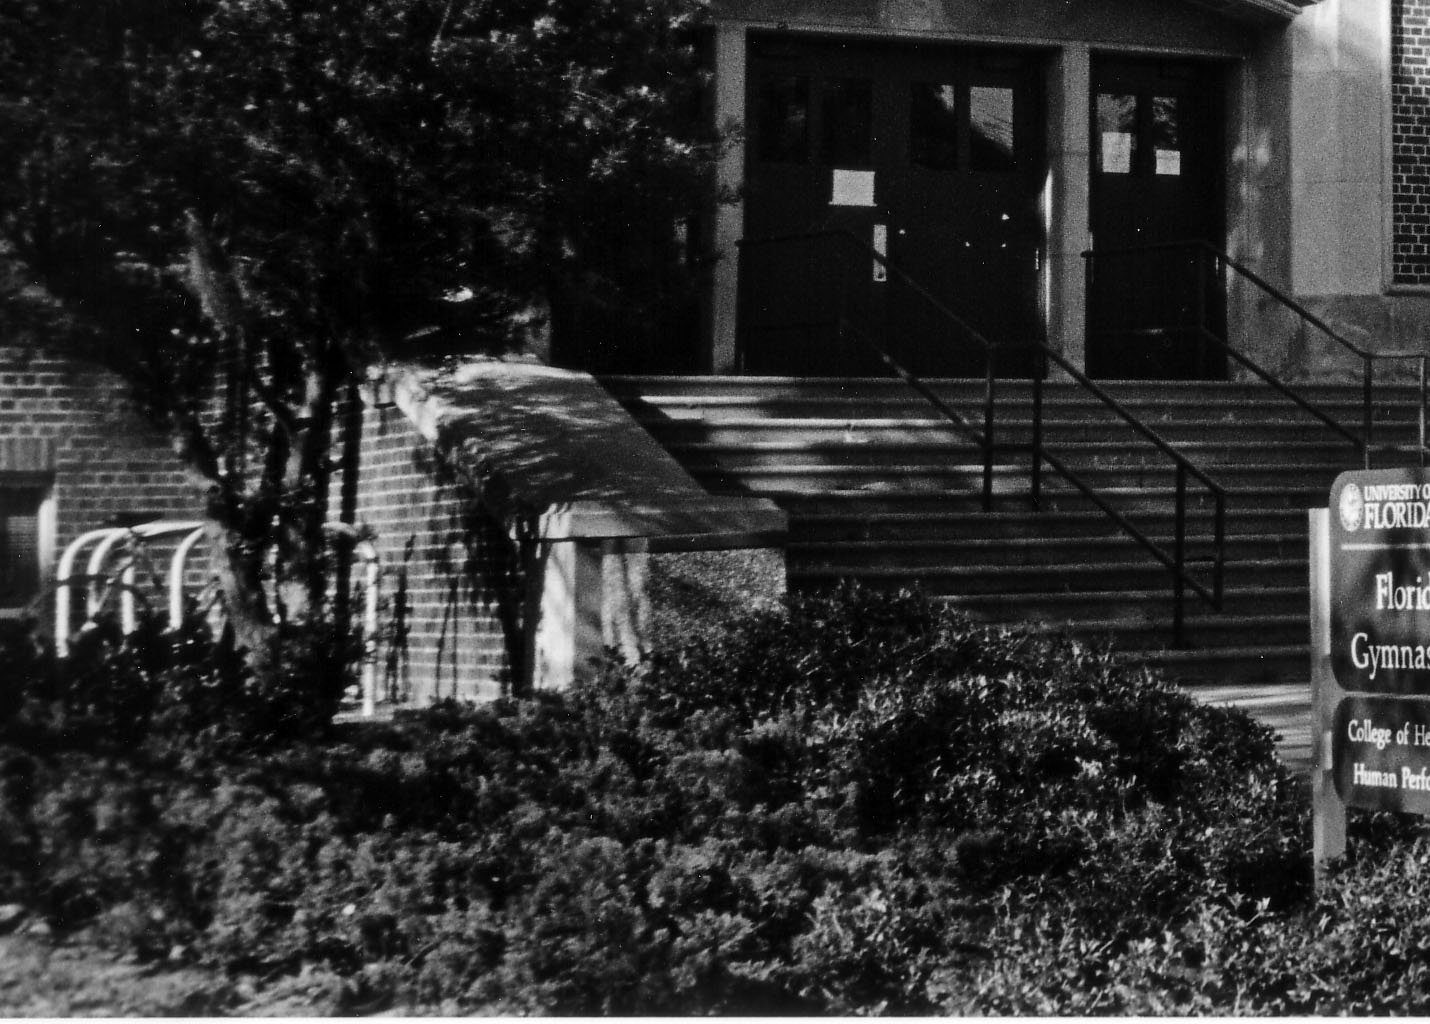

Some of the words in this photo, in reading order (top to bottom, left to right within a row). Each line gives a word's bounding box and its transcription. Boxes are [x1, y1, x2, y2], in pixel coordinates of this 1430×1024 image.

[1363, 484, 1421, 501] UNIVERSITY
[1348, 719, 1392, 750] College
[1396, 721, 1409, 746] of
[1353, 762, 1398, 789] Human
